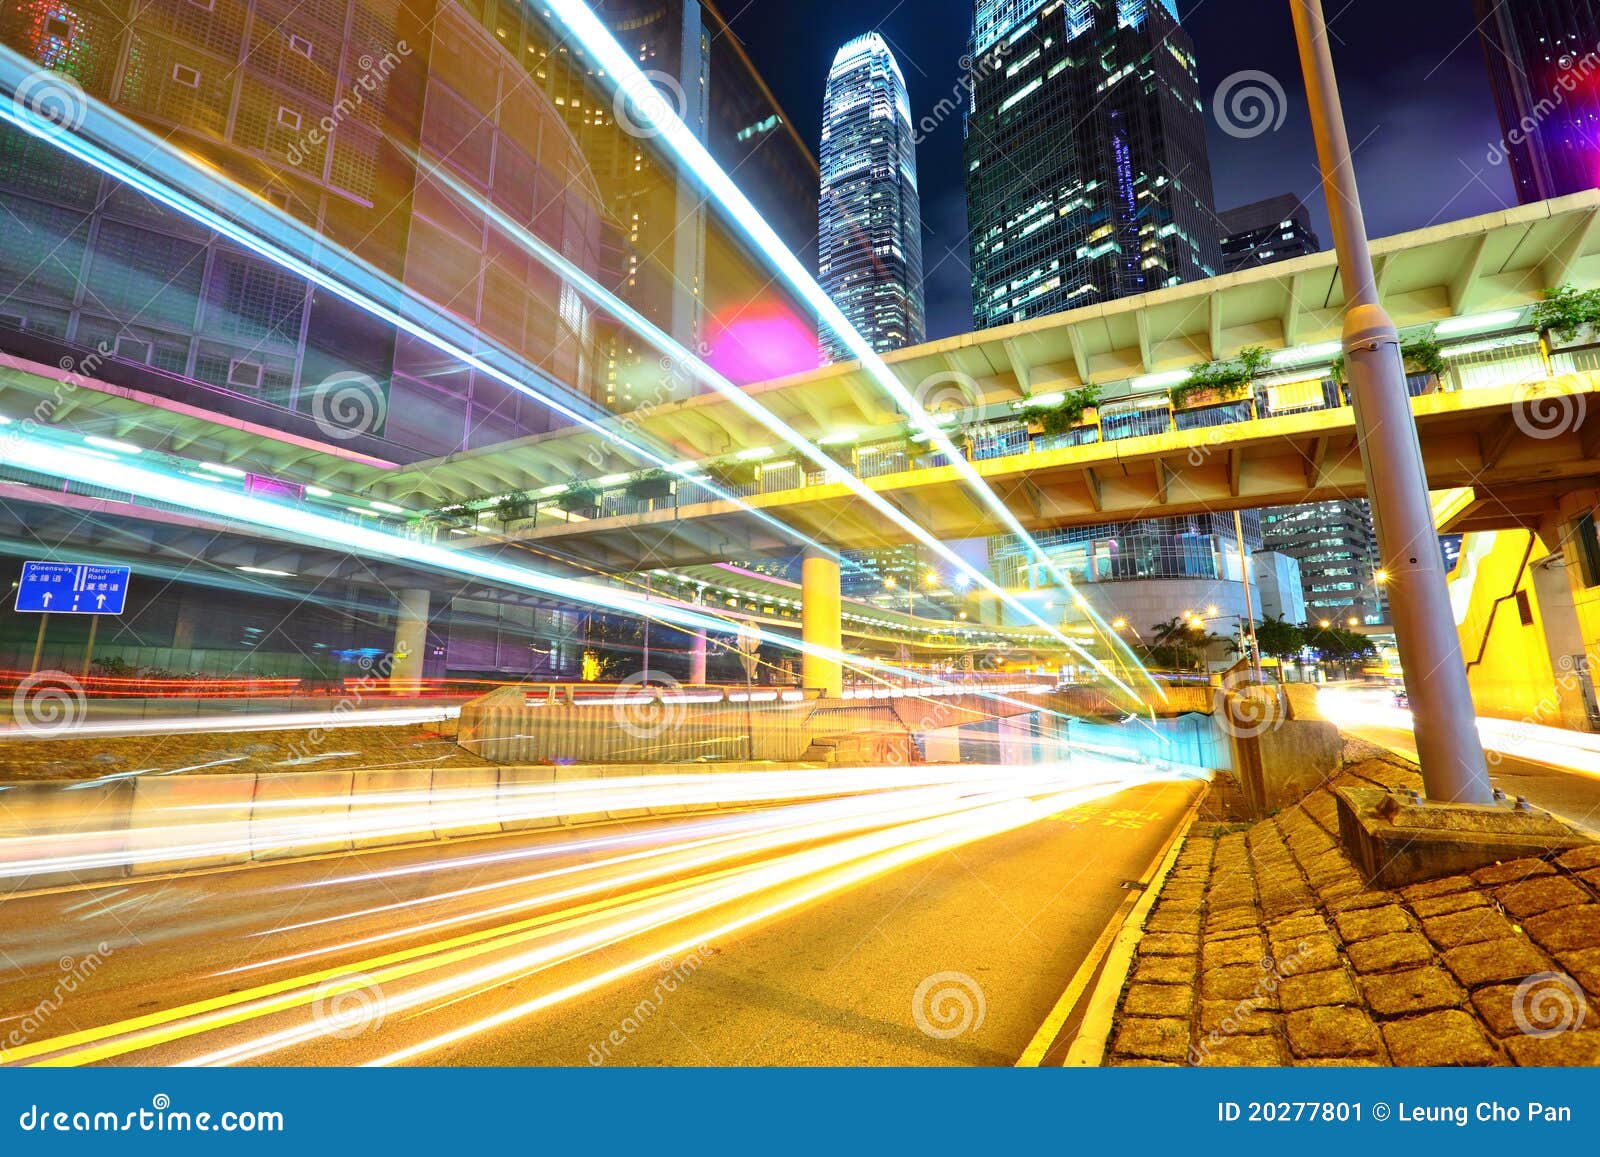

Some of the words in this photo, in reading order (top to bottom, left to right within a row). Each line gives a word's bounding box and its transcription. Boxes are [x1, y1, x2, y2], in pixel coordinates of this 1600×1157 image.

[30, 564, 73, 573] Queensway
[88, 567, 121, 575] Harcourt
[87, 573, 107, 581] Road
